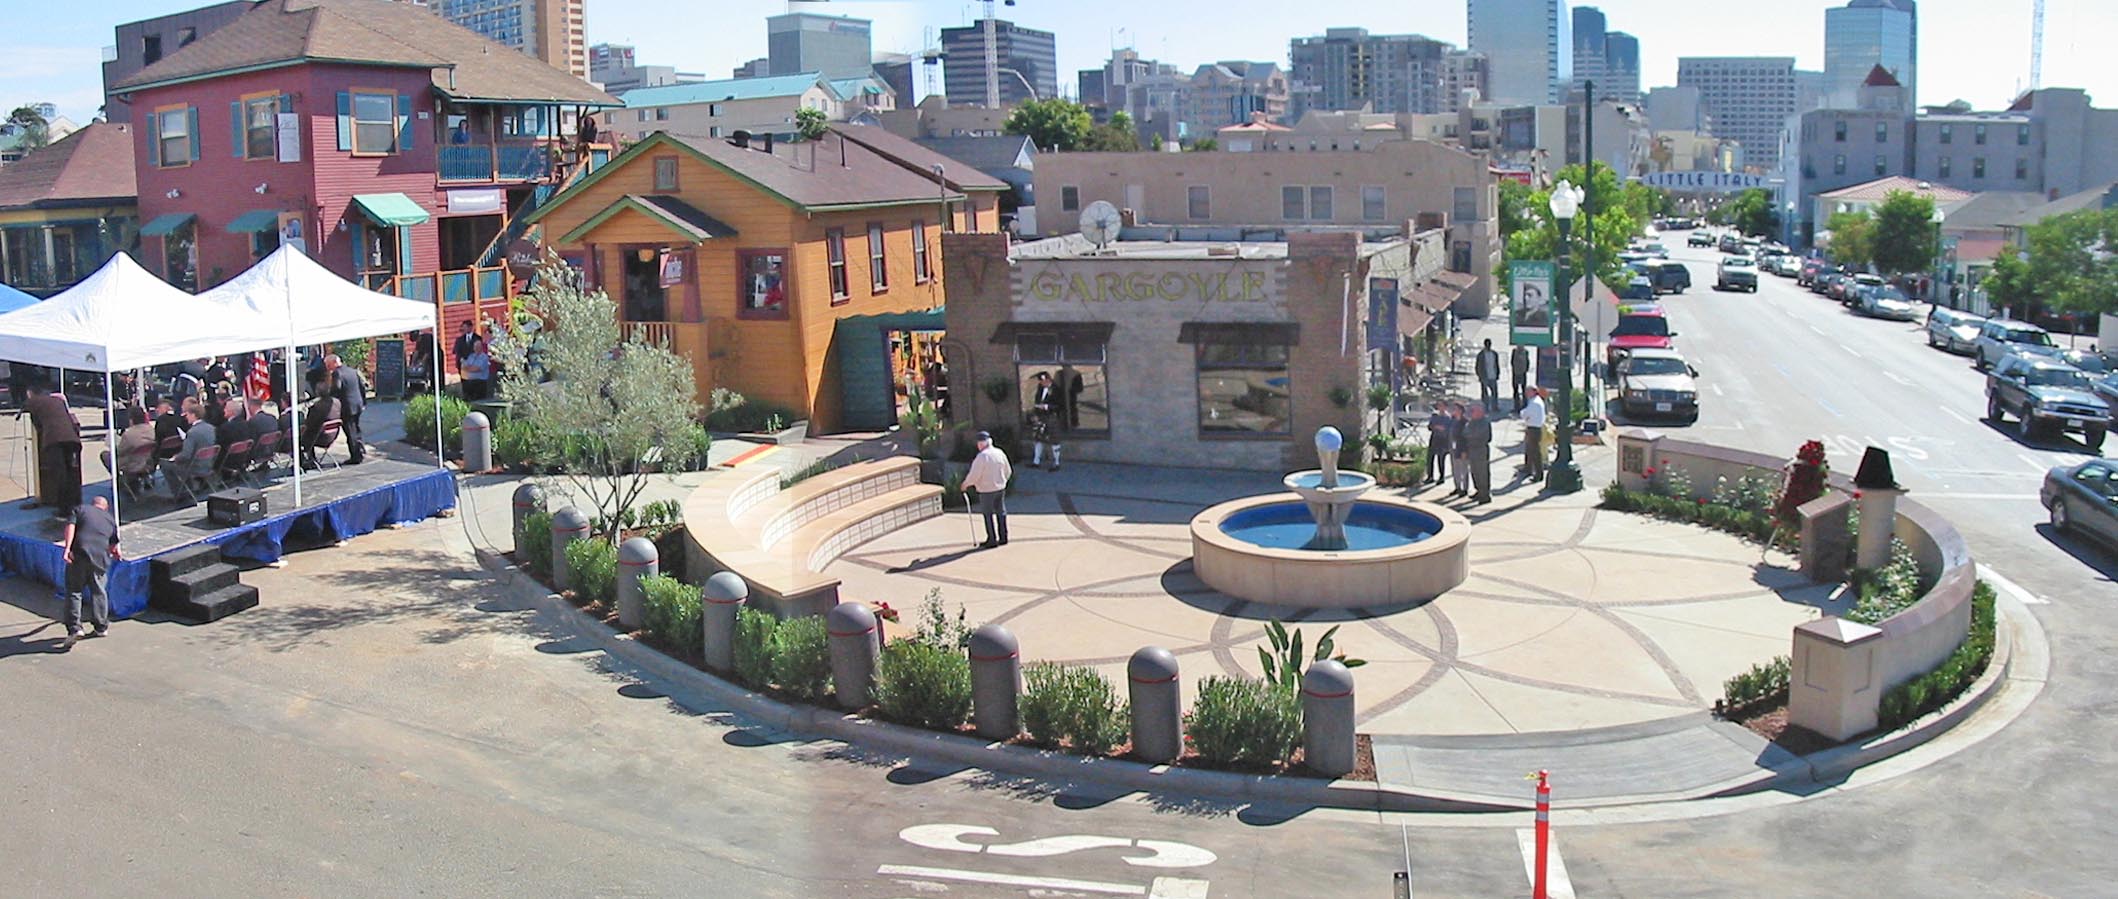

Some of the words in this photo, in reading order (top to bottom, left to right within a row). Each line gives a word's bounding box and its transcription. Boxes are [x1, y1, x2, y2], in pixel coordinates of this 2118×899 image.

[1648, 173, 1705, 186] LITTLE
[1714, 173, 1762, 187] ITALY
[1031, 271, 1267, 302] GARGOYLE
